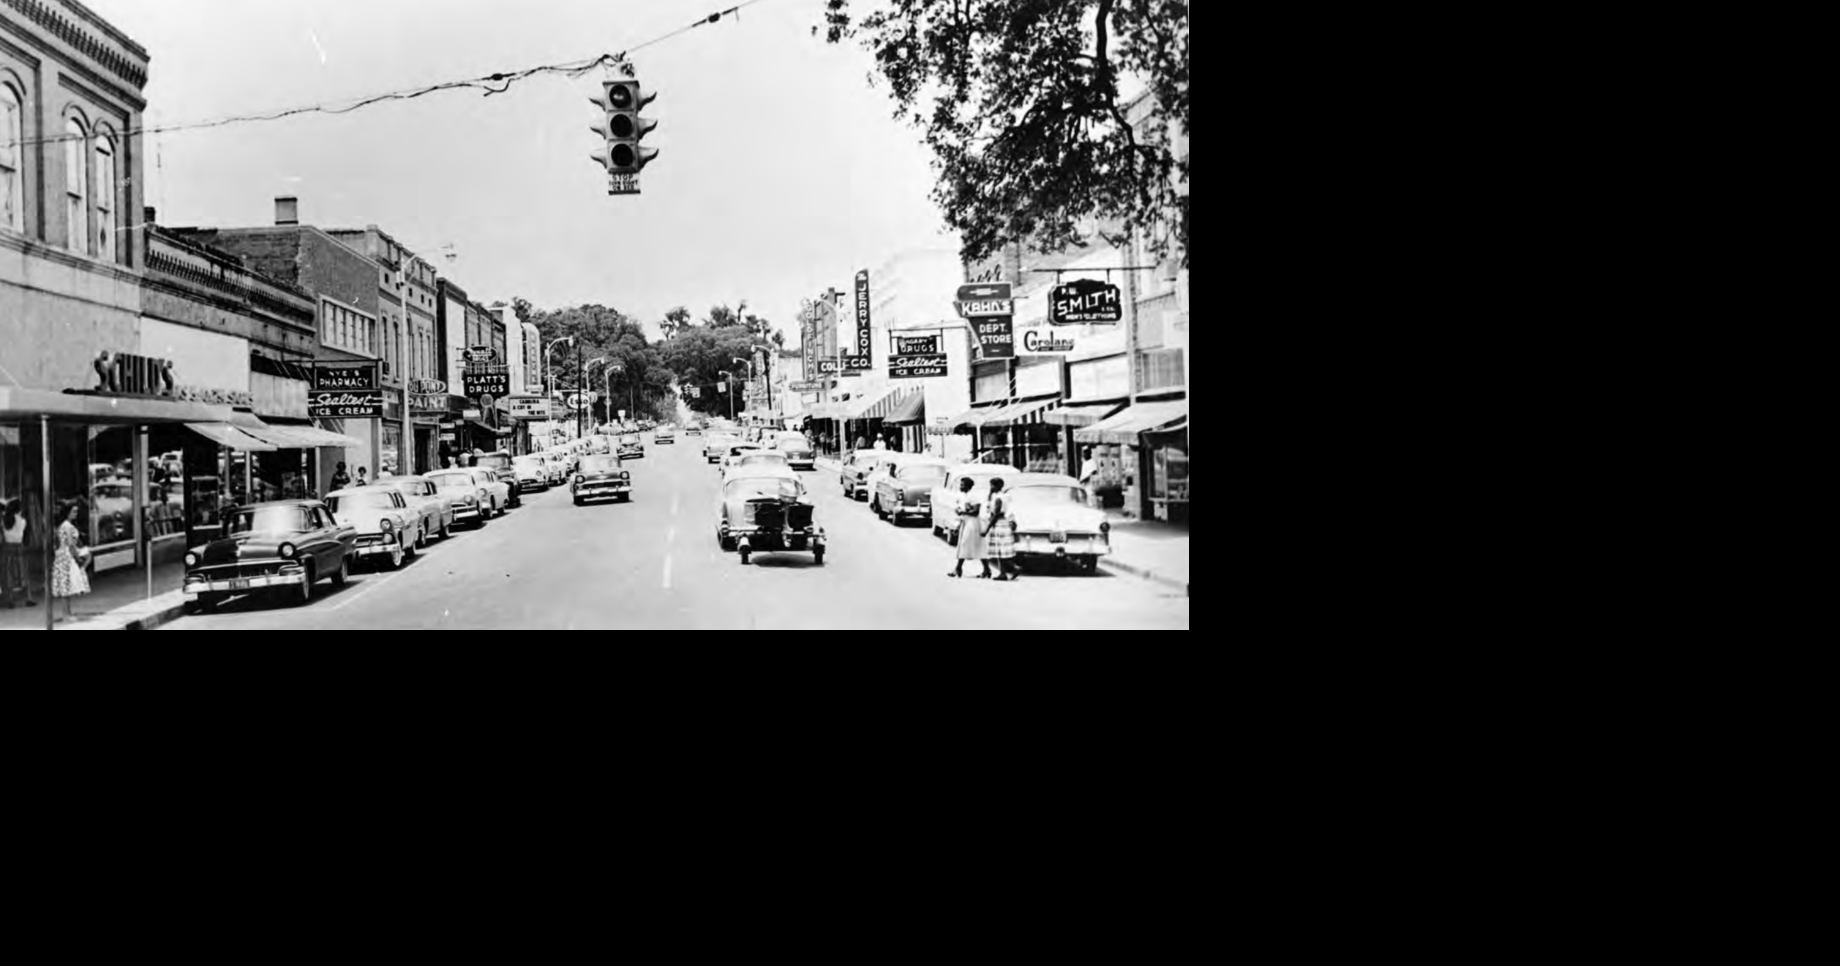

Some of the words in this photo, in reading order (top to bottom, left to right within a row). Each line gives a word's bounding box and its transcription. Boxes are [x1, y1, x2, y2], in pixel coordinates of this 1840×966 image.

[858, 283, 868, 327] JERRY
[1057, 288, 1117, 317] SMITH
[979, 323, 1008, 334] DEPT.
[860, 329, 869, 357] COX
[980, 334, 1012, 345] STORE
[900, 344, 935, 353] DRUGS
[319, 377, 370, 388] PHARMACY
[466, 375, 506, 384] PLATT'S
[469, 385, 504, 393] DRUGS
[316, 393, 374, 406] Sealtest
[408, 396, 447, 410] PAINT
[315, 407, 331, 415] ICE
[338, 407, 374, 415] CREAM
